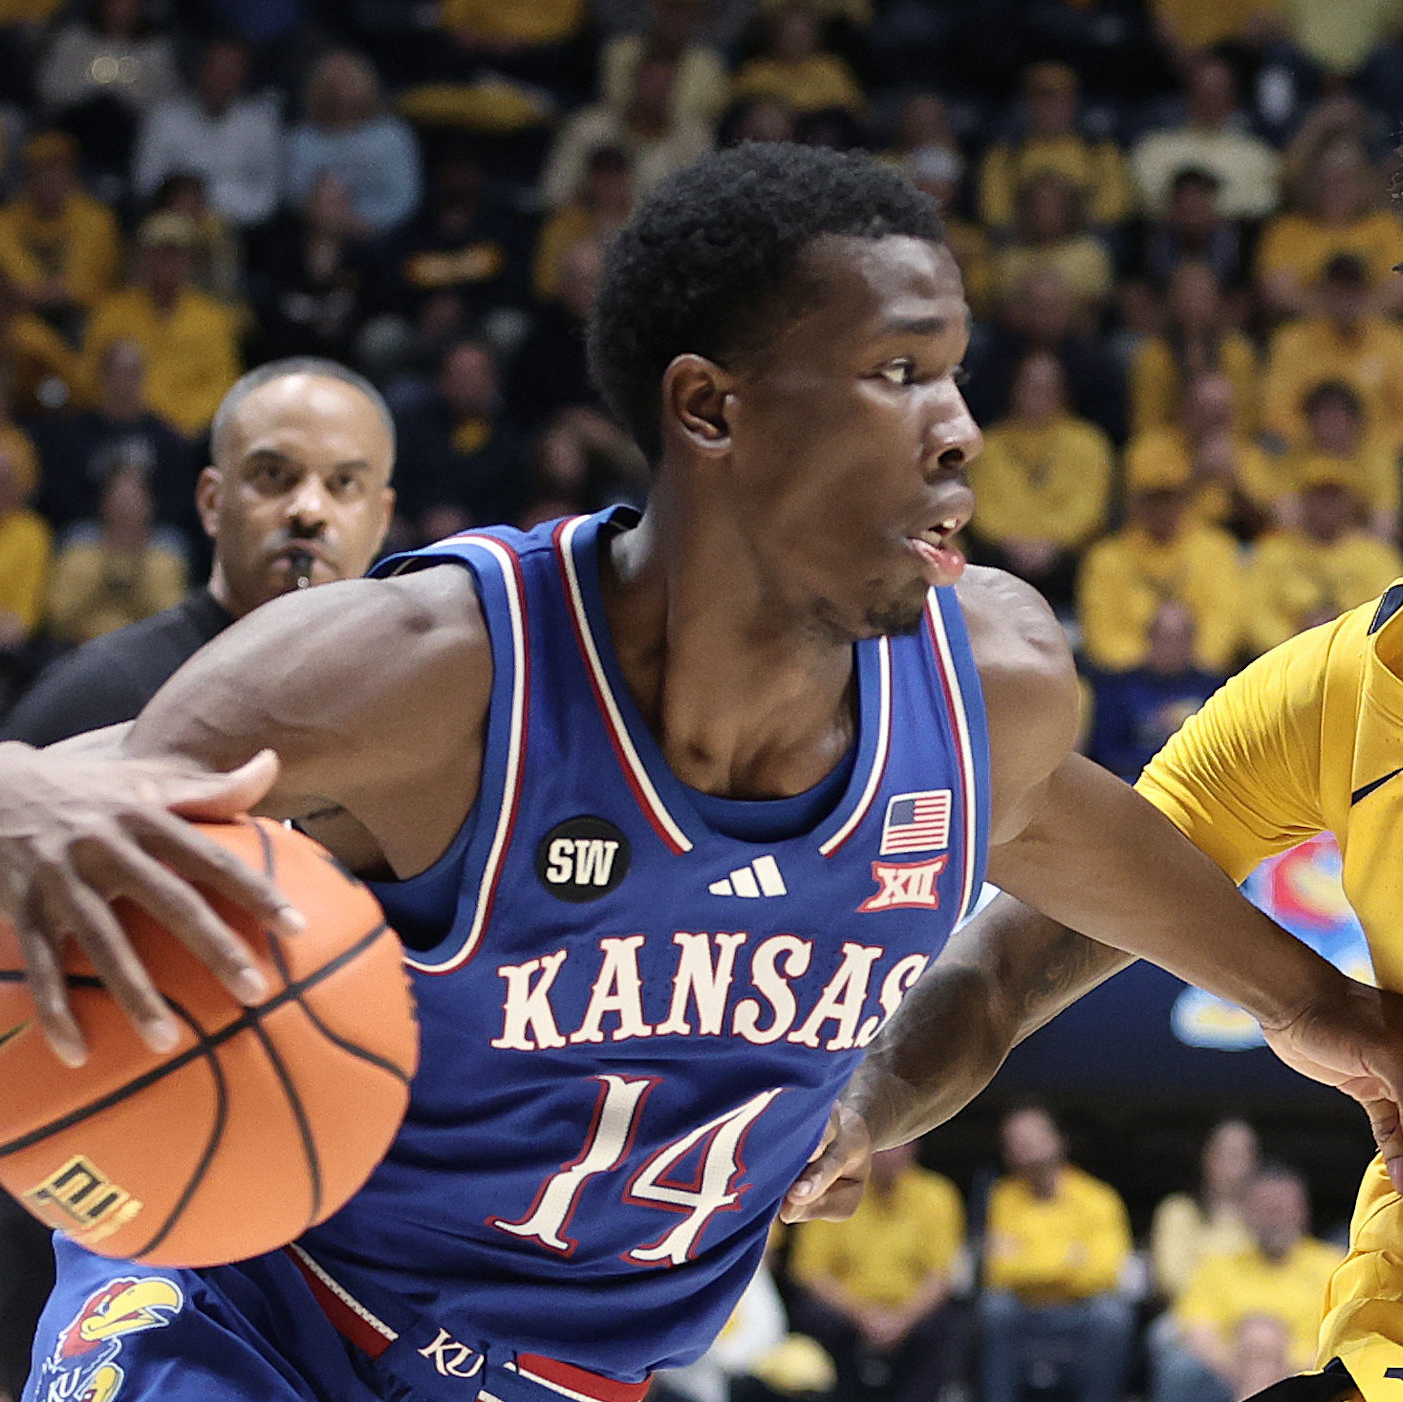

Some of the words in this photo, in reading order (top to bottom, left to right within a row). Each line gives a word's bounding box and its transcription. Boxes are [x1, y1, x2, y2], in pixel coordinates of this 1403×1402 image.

[546, 838, 619, 887] SW
[862, 859, 945, 910] XII
[486, 1073, 784, 1268] 14
[417, 1327, 485, 1378] KU
